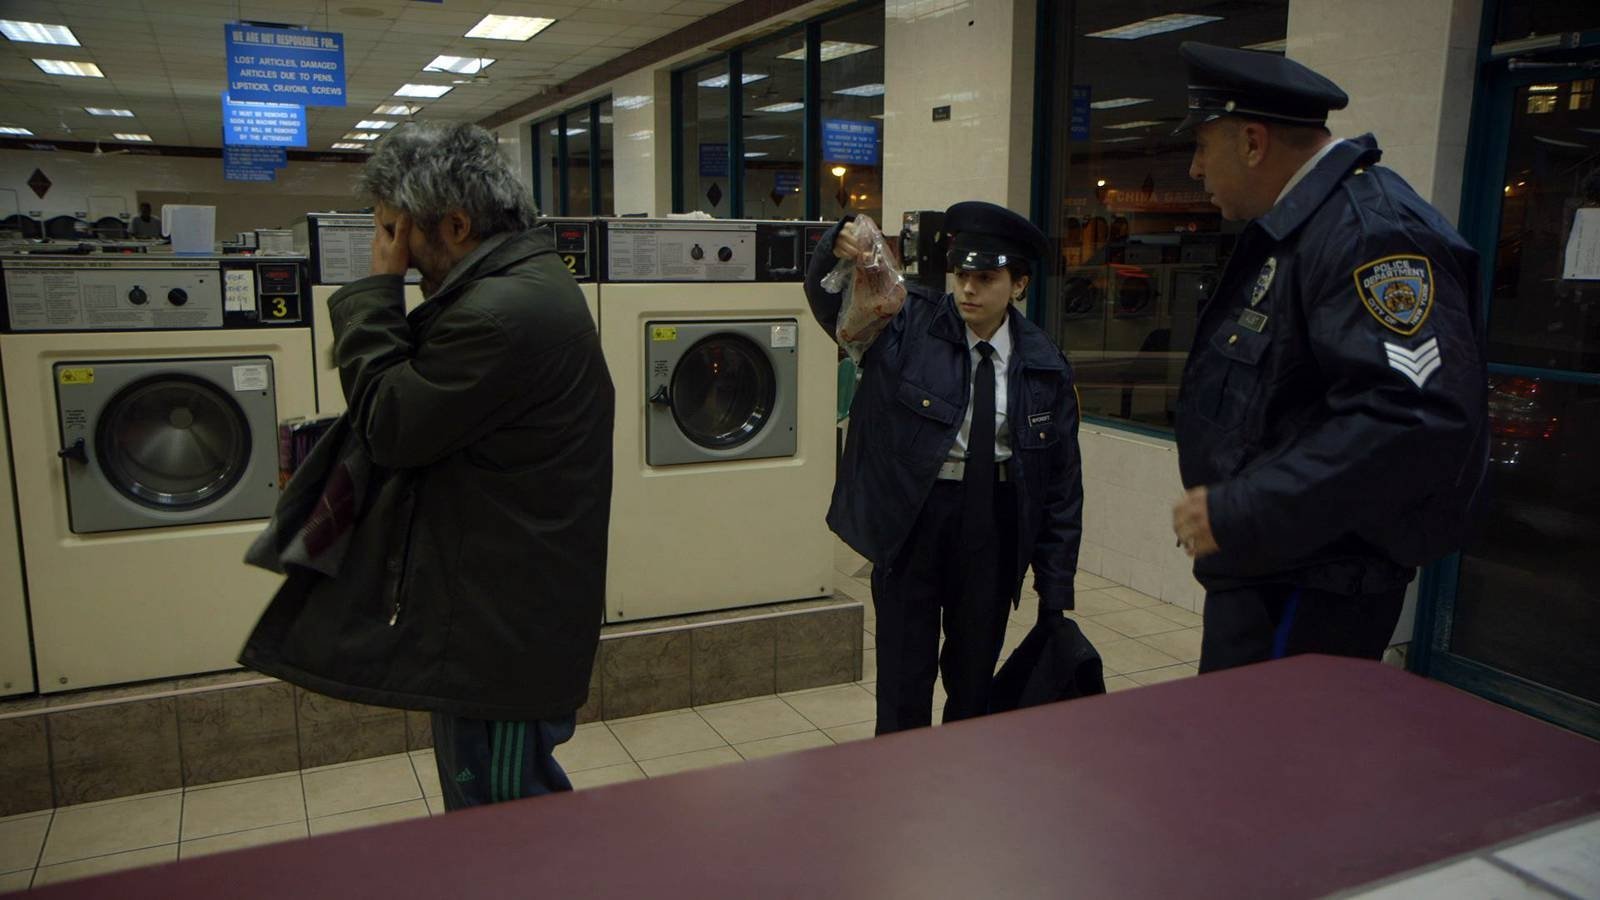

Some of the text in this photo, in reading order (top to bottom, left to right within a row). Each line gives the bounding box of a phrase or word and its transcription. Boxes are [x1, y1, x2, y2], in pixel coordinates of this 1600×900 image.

[233, 31, 243, 42] WE
[246, 31, 258, 43] ARE
[261, 33, 274, 44] NOT
[276, 34, 319, 48] RESPONSIBLE
[235, 56, 337, 70] LOST ARTICLES, DAMAGED
[240, 69, 334, 83] ARTICLES DUE TO PENS,
[232, 82, 342, 96] LIPSTICKS, CRAYONS, SCREWS
[273, 127, 298, 135] REMOVED
[1117, 191, 1158, 202] CHINA
[563, 255, 577, 273] 2
[1374, 260, 1409, 274] POLICE
[1363, 267, 1425, 288] DEPARTMENT
[272, 297, 288, 318] 3
[1368, 283, 1428, 326] CITY OF NEW YORK
